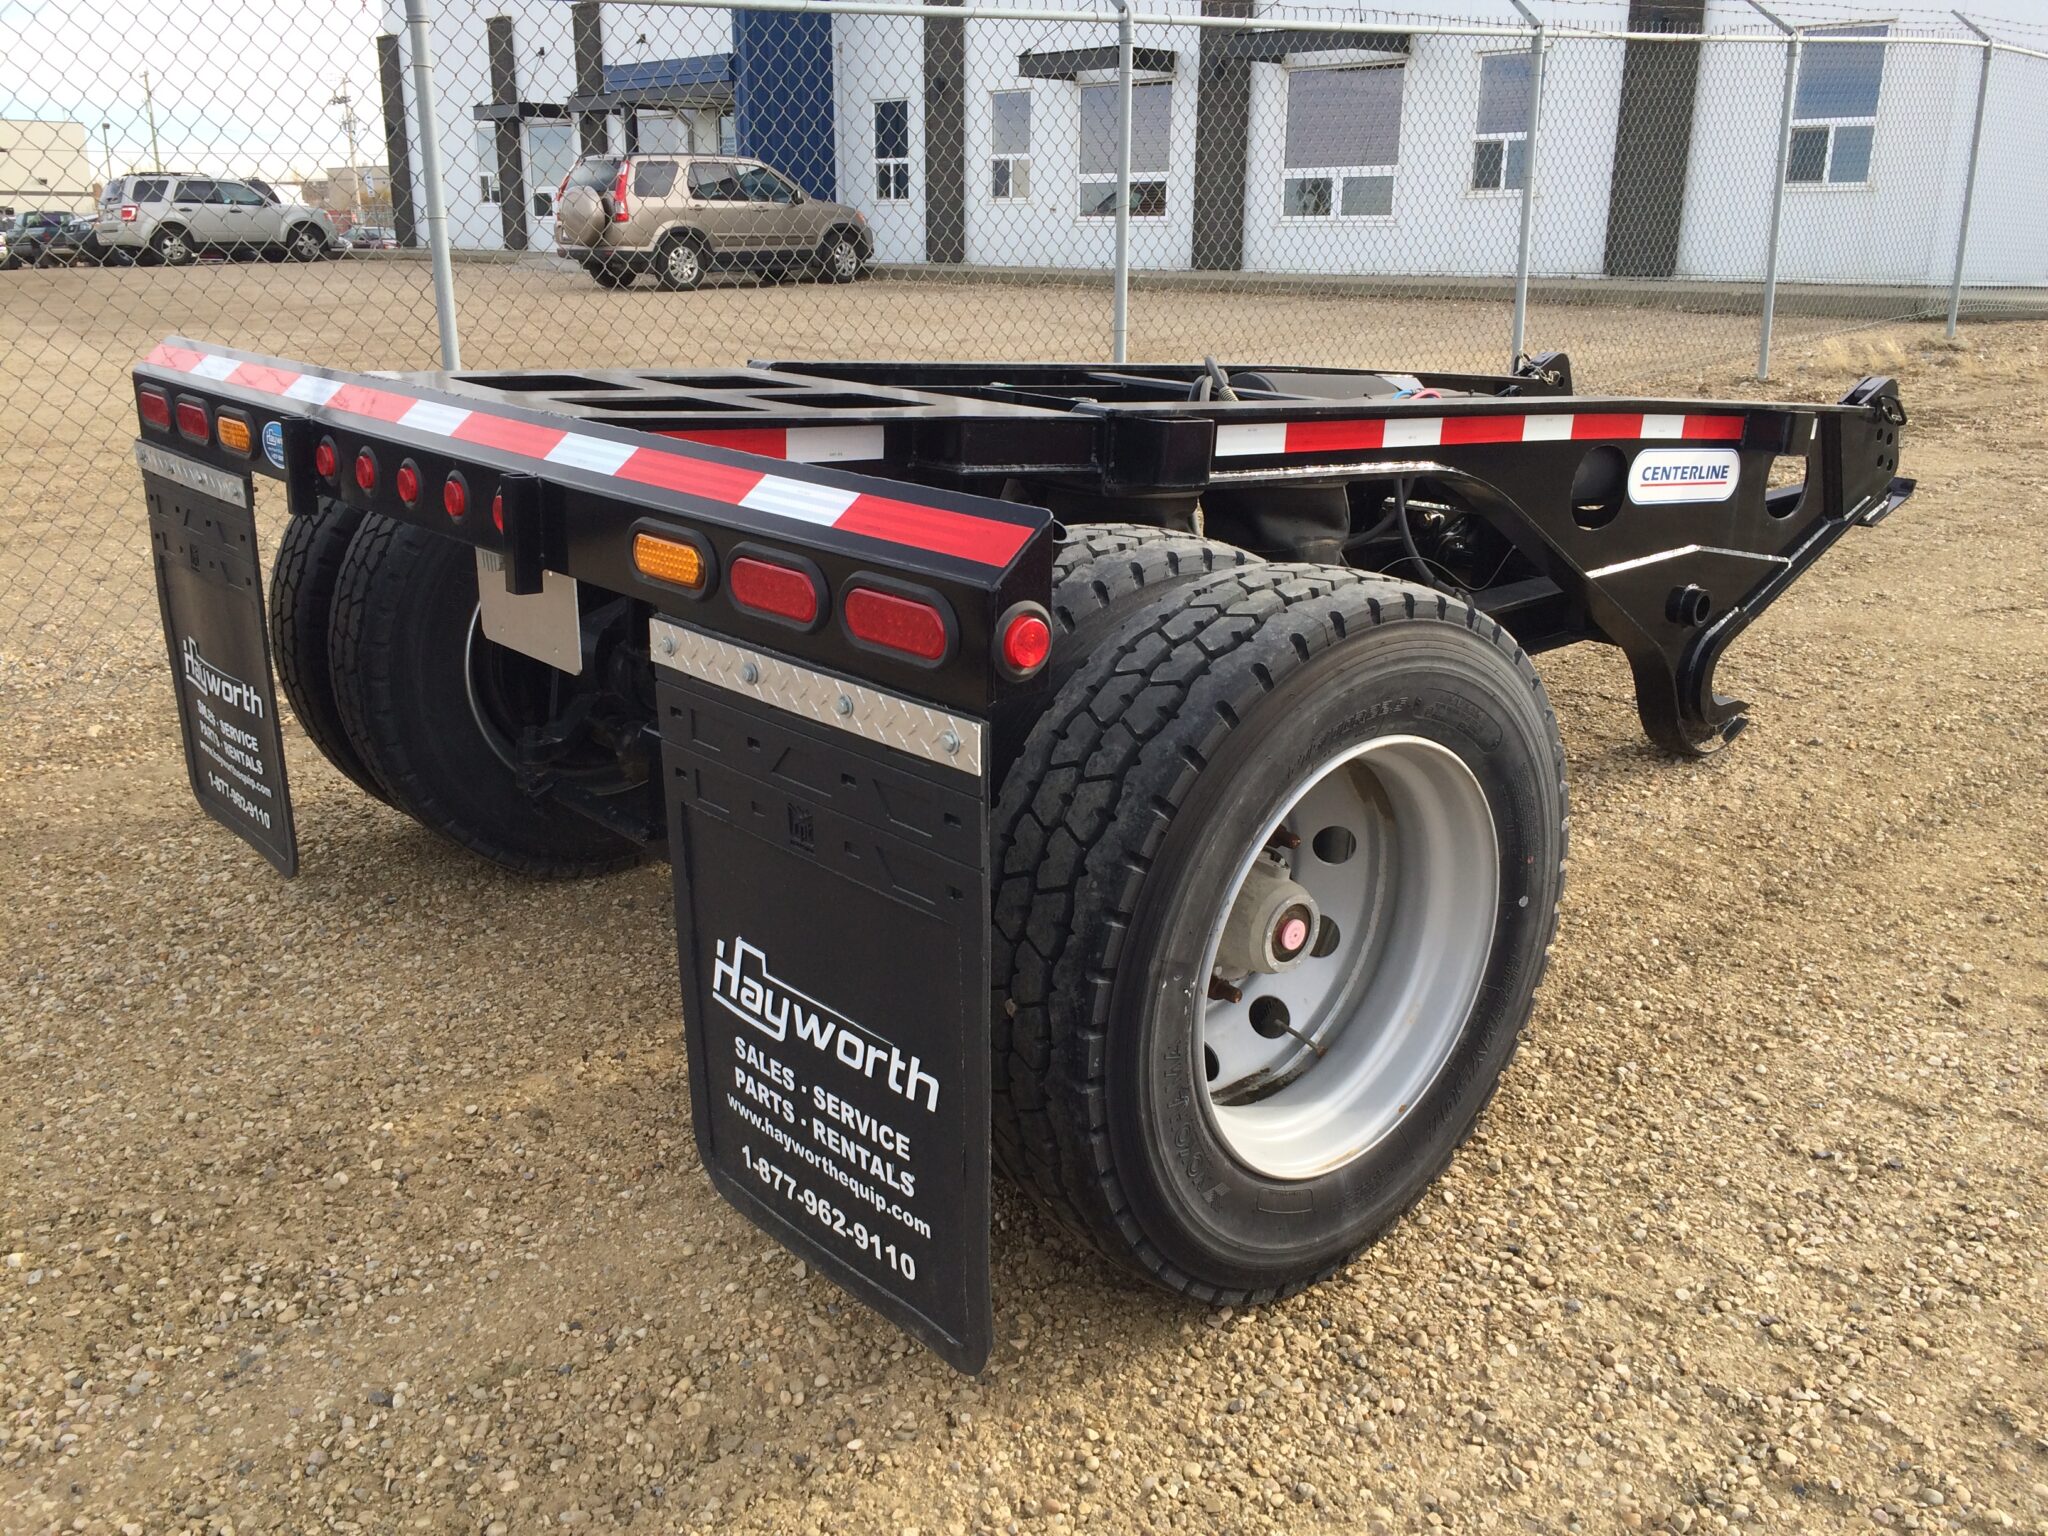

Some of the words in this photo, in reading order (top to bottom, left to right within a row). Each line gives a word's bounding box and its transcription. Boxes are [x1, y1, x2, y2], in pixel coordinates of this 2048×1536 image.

[1641, 465, 1730, 481] CENTERLINE
[183, 636, 263, 718] Hayworth
[220, 719, 259, 752] SERVICE
[223, 741, 263, 775] RENTALS
[713, 936, 940, 1112] Hayworth
[735, 1036, 795, 1091] SALES
[814, 1085, 911, 1161] SERVICE
[735, 1067, 795, 1124] PARTS
[814, 1118, 915, 1198] RENTALS
[727, 1092, 931, 1240] www.hayworthequip.com
[741, 1145, 916, 1281] 1-877-962-9110
